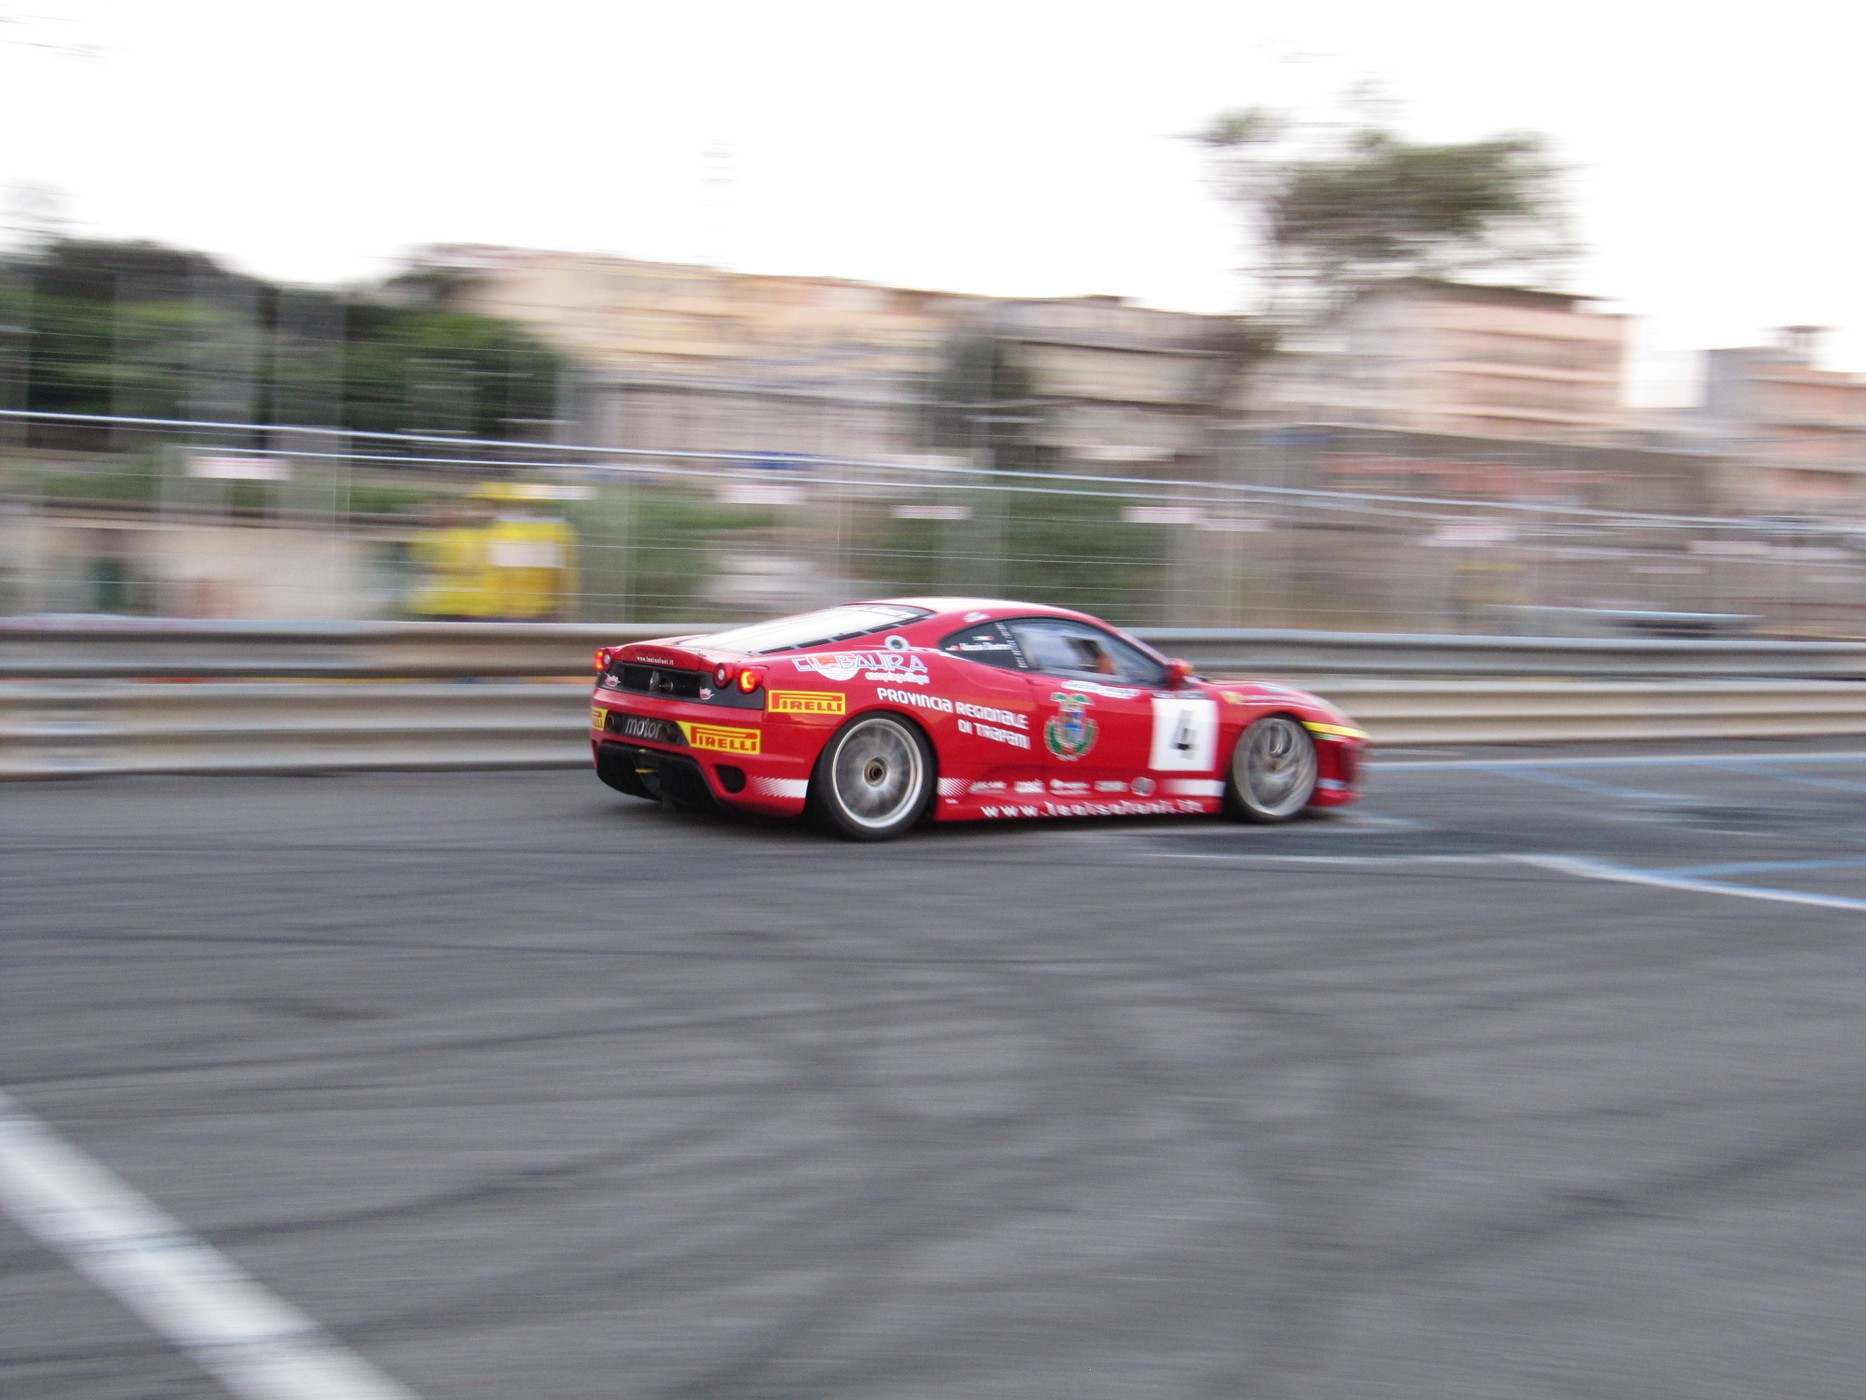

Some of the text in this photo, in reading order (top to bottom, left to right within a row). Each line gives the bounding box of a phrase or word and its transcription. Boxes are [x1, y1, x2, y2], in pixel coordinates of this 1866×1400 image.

[771, 692, 843, 712] PIRELLI
[625, 718, 662, 739] motor
[957, 719, 973, 735] DI
[1170, 709, 1195, 760] 4
[690, 725, 758, 752] PIRELLI
